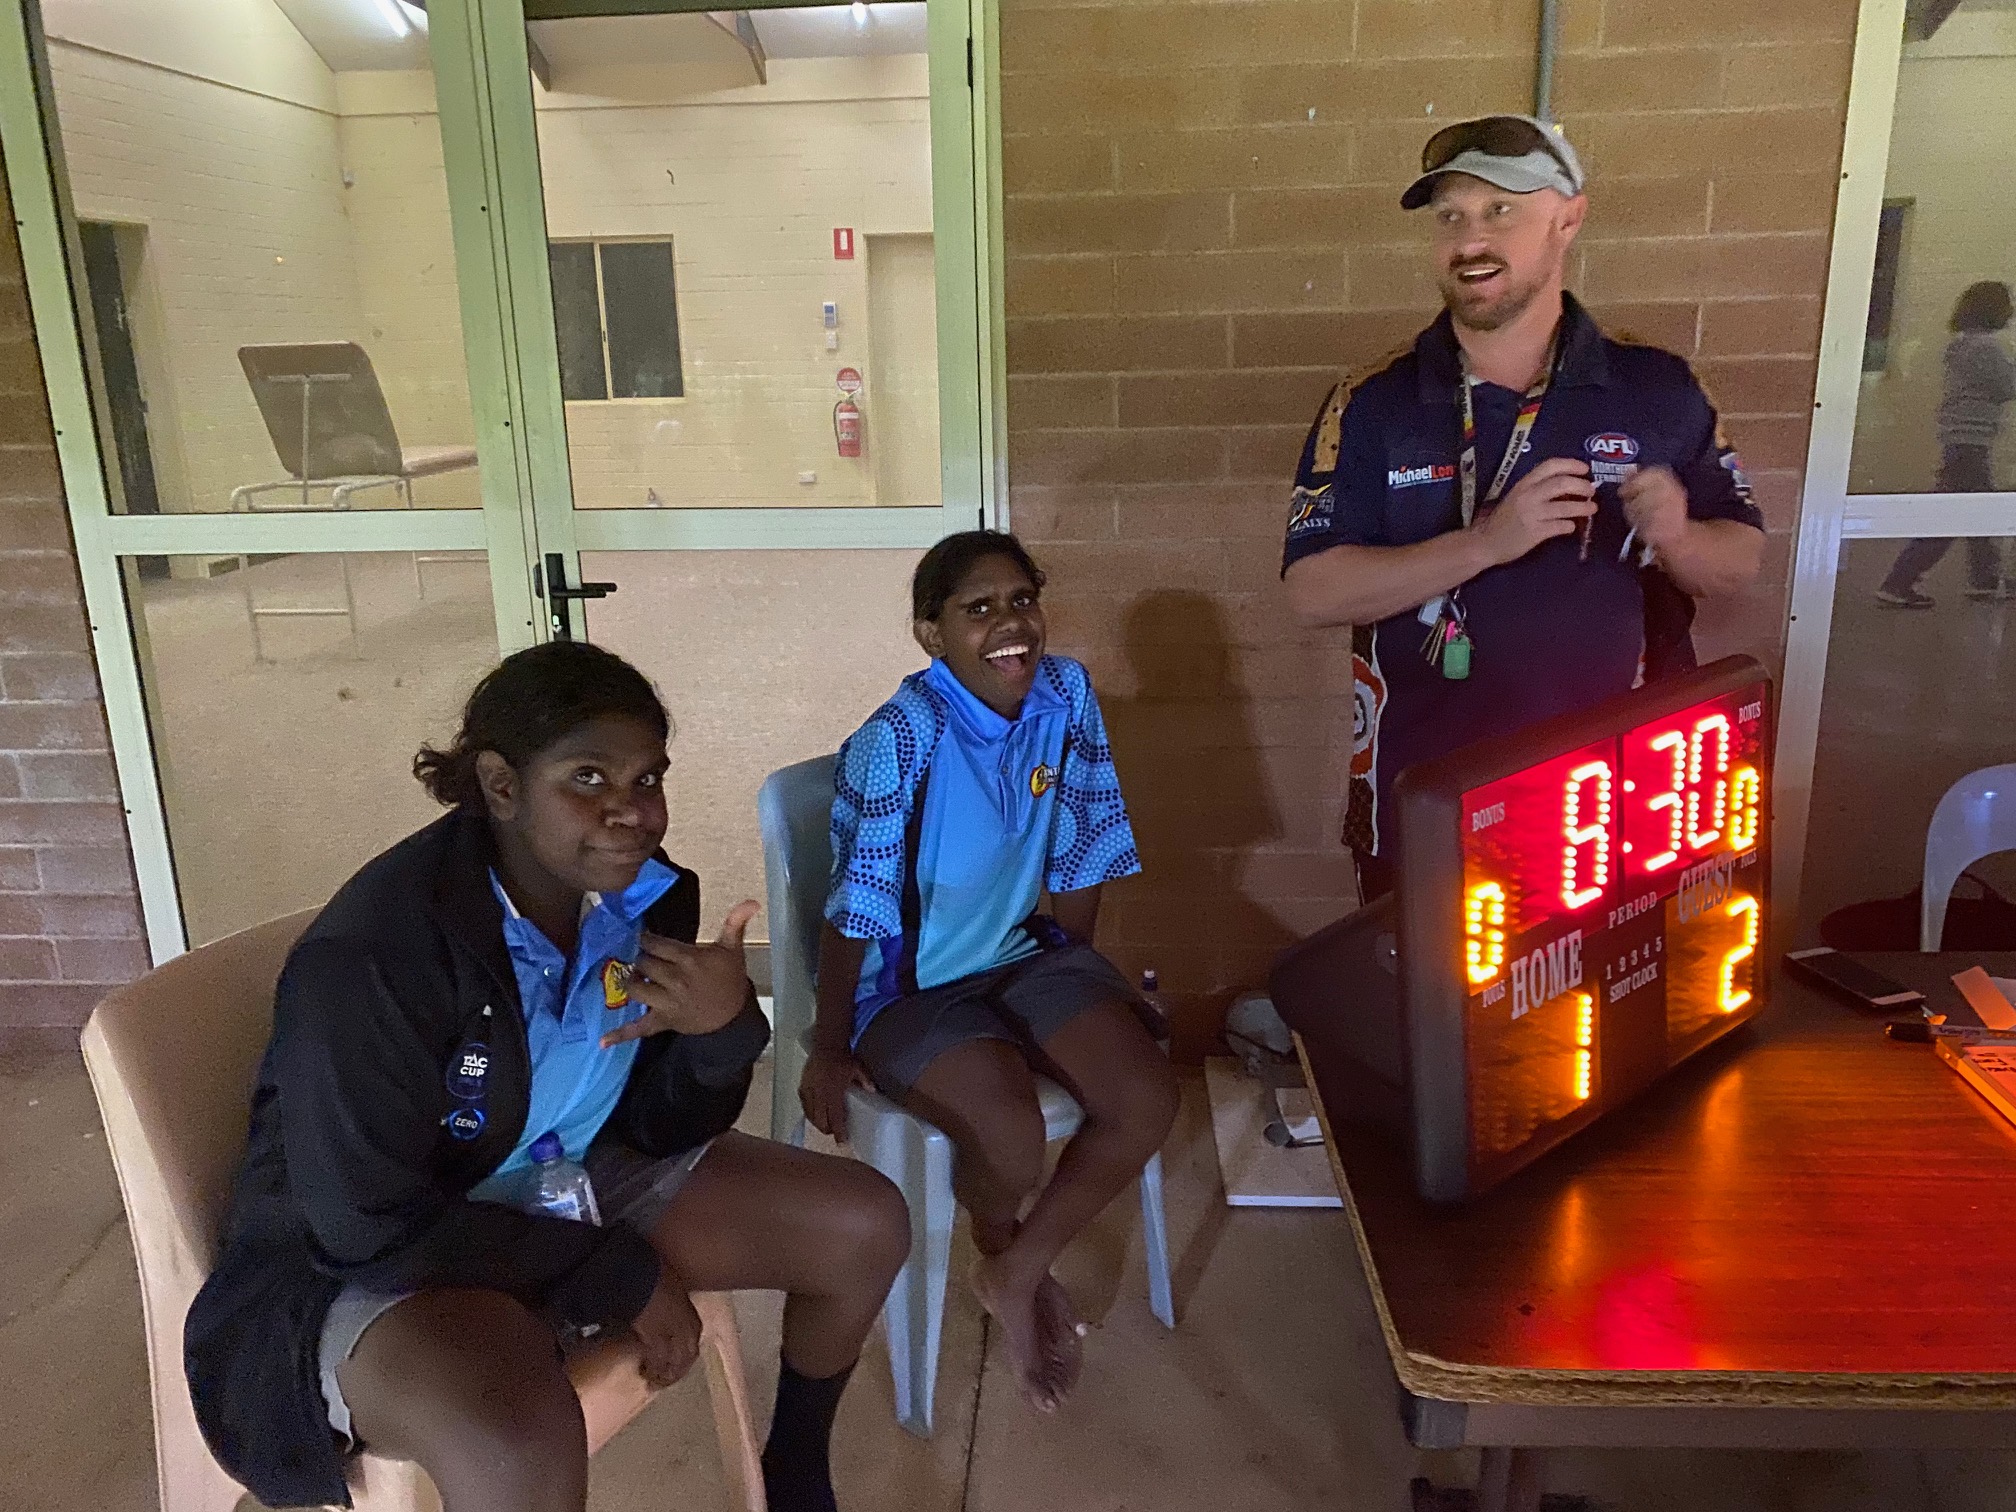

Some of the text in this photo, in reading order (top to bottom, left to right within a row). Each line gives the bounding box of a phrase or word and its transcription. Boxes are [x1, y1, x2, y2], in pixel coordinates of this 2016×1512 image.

[1592, 438, 1634, 455] AFL
[1472, 802, 1506, 832] BONUS
[1731, 766, 1760, 851] 0
[1679, 852, 1736, 924] GUEST
[1608, 891, 1658, 930] PERIOD
[1466, 881, 1505, 983] 0
[1511, 929, 1583, 1020] HOME
[1606, 936, 1662, 980] 1 2 3 4 5
[1720, 896, 1759, 1013] 2
[1610, 962, 1658, 1003] SHOT CLOCK
[463, 1053, 488, 1068] TAC
[1574, 994, 1593, 1100] 1
[460, 1066, 485, 1077] CUP
[455, 1117, 478, 1129] ZERO
